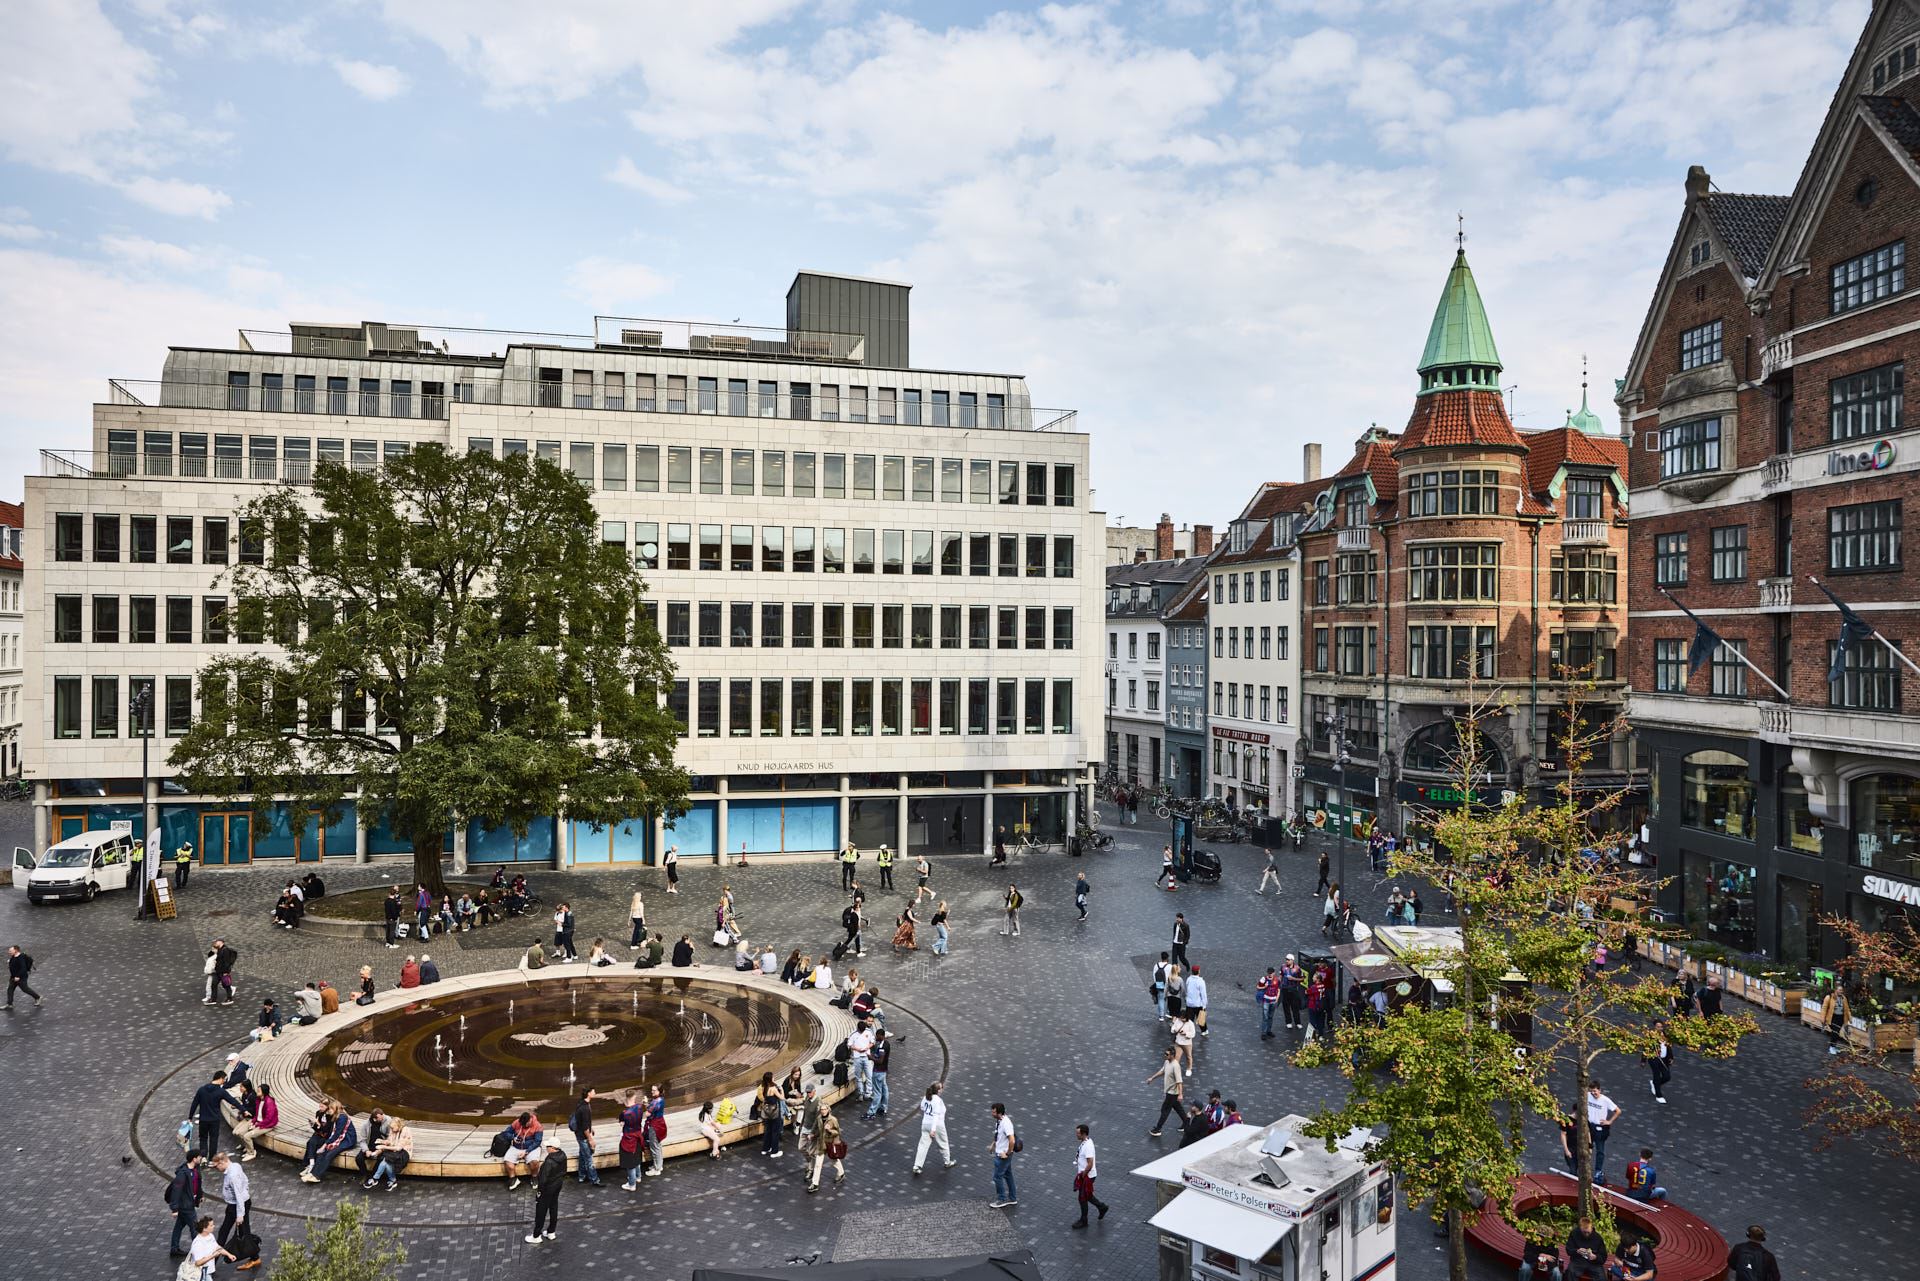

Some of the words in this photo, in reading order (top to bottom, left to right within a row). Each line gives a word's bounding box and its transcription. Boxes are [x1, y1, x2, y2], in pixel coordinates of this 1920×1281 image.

[737, 763, 760, 771] KNUD
[764, 761, 815, 771] HØJGAARDS
[818, 761, 834, 770] HUS
[1539, 761, 1556, 770] NEYE
[1211, 1183, 1239, 1200] Peter's
[1241, 1193, 1267, 1209] Pølser
